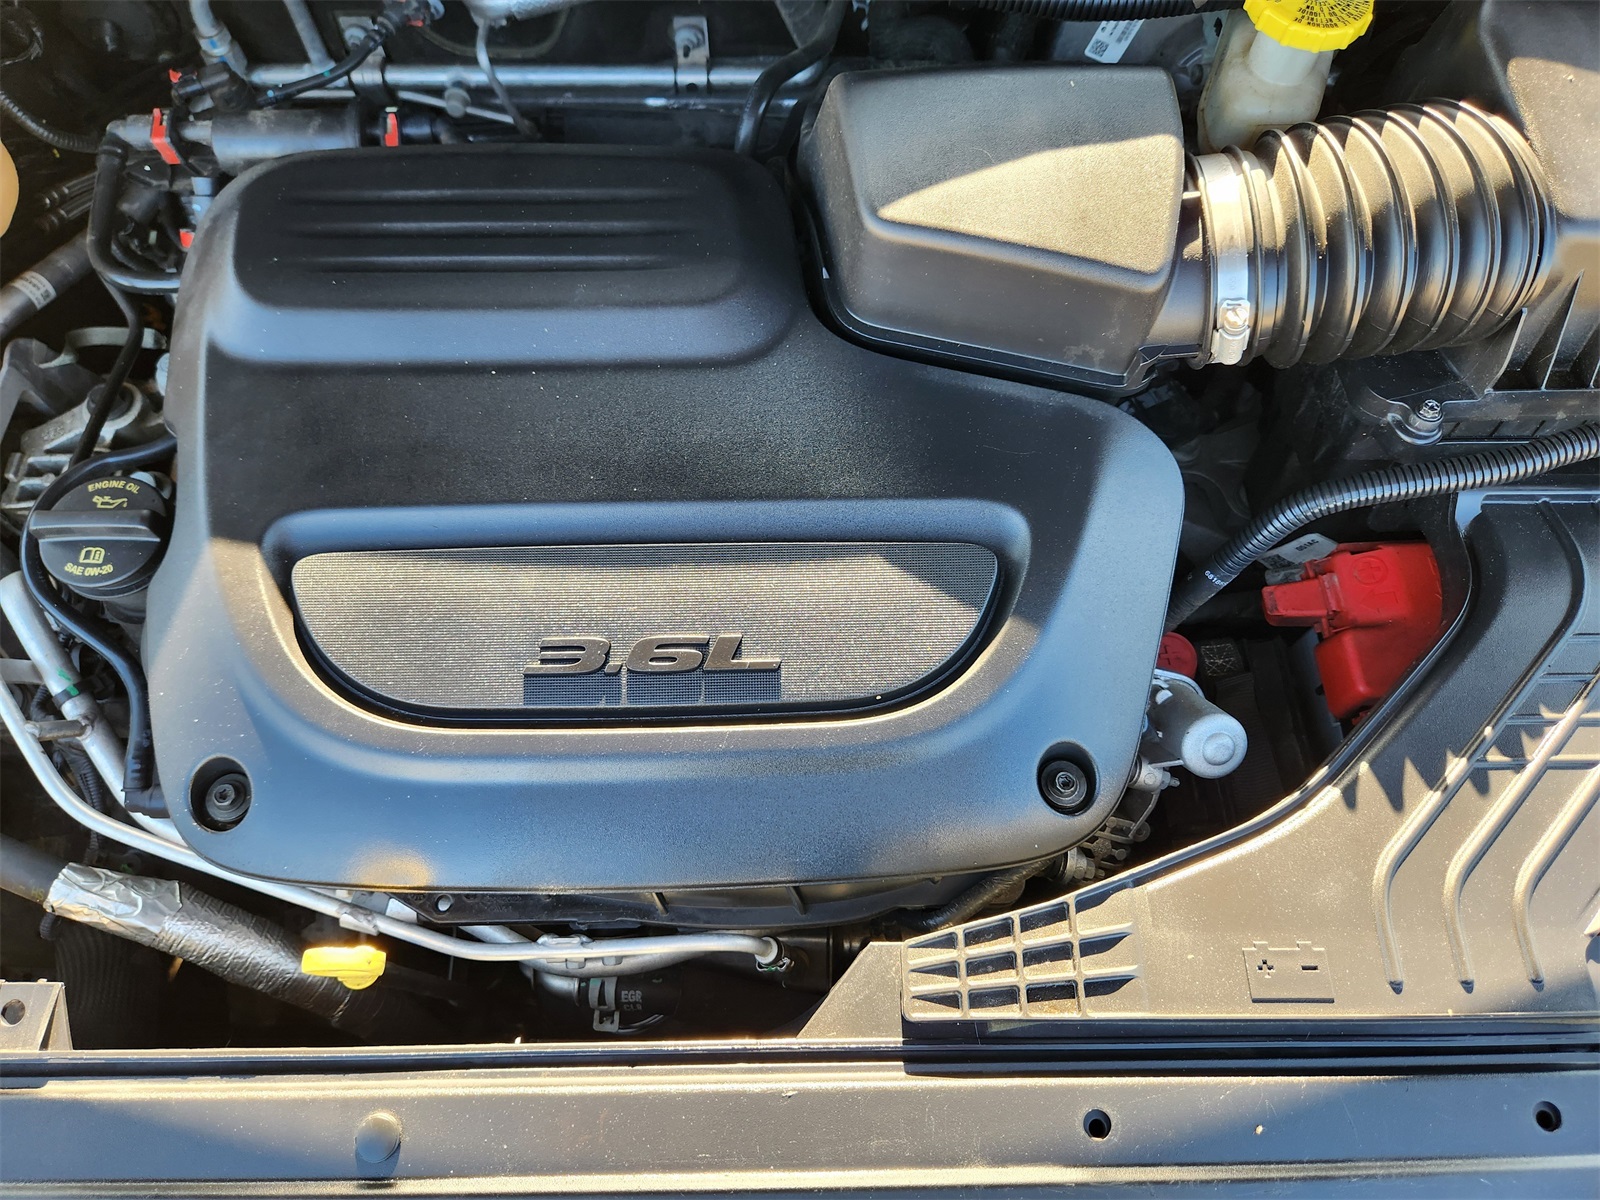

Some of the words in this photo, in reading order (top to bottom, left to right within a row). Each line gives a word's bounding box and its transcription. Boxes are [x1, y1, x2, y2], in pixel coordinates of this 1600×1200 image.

[87, 480, 125, 493] ENGINE
[125, 481, 141, 494] OIL
[64, 562, 85, 576] SAE
[84, 563, 114, 577] 0W-20
[523, 634, 782, 676] 3.6L
[621, 989, 643, 1003] EGR
